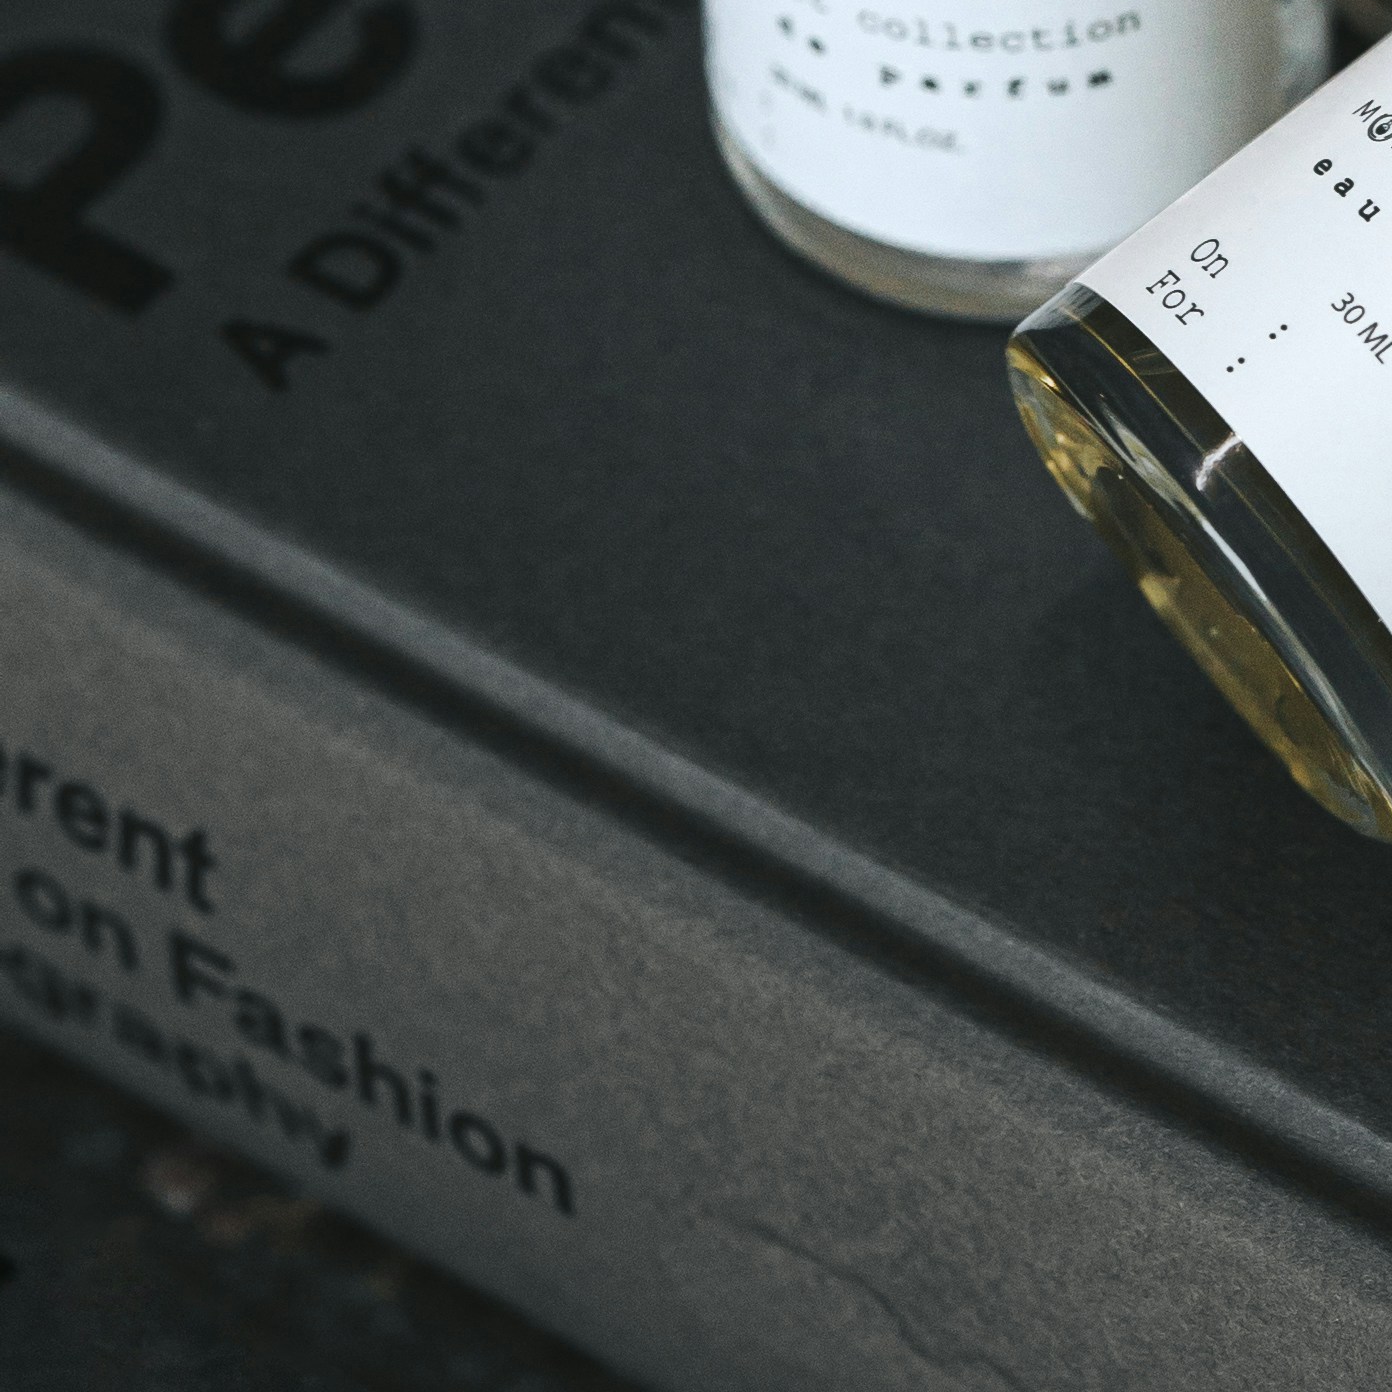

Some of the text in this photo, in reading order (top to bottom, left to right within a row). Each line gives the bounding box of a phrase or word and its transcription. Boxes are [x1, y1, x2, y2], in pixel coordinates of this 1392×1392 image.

[856, 8, 1142, 54] collection
[1313, 157, 1380, 222] eau
[1190, 238, 1229, 279] On
[1145, 269, 1205, 326] For
[219, 315, 332, 394] A
[13, 867, 576, 1218] on Fashion
